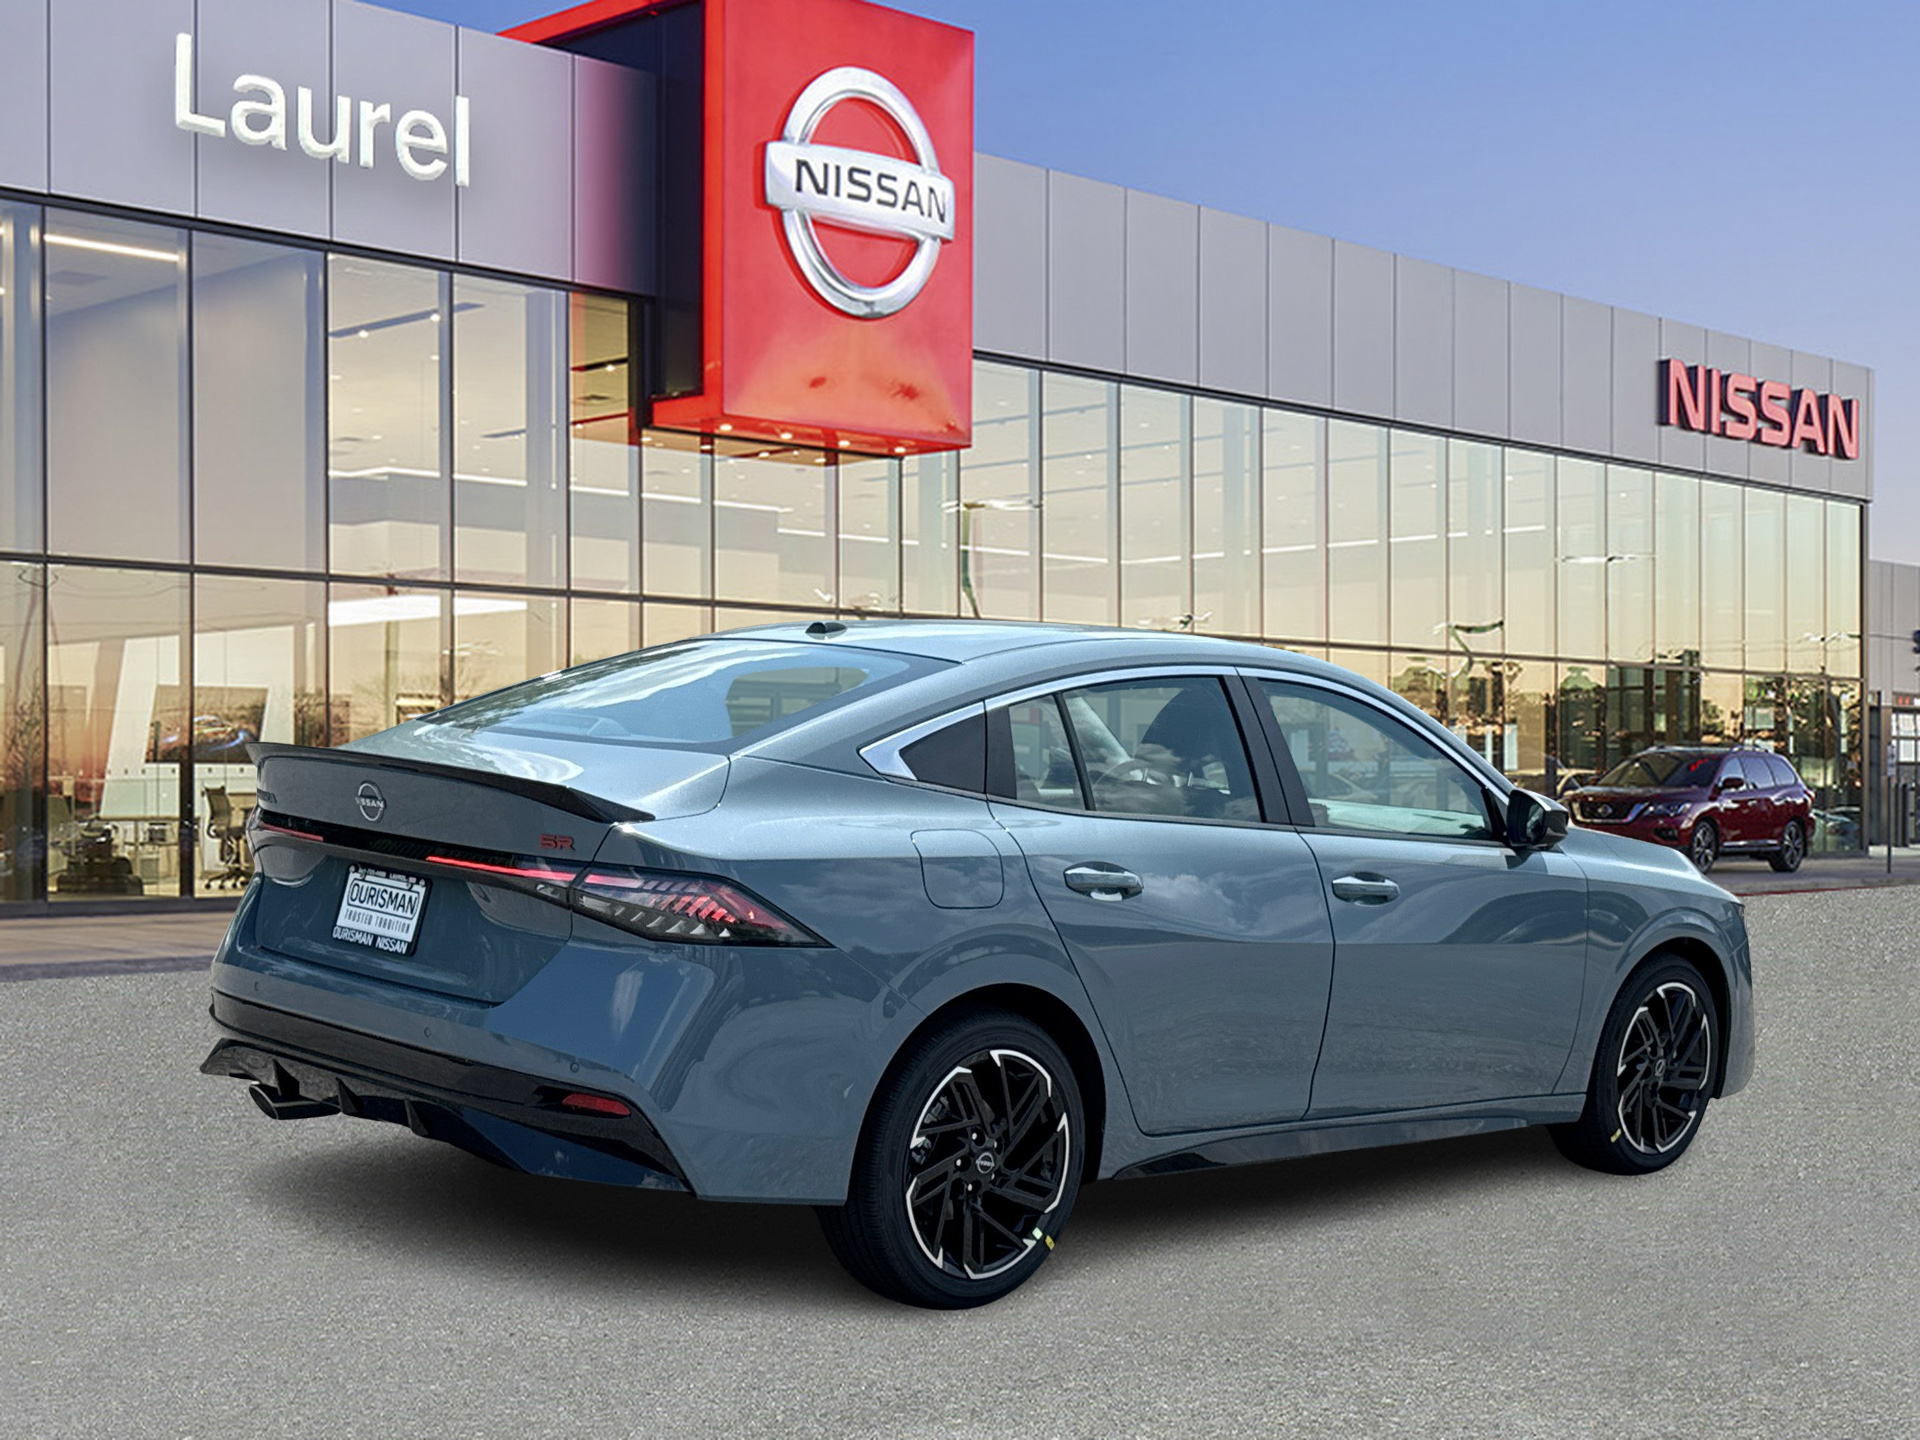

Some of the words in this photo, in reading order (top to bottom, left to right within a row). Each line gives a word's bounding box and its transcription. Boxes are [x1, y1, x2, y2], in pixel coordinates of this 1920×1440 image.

[175, 33, 469, 187] Laurel
[796, 159, 945, 223] NISSAN
[1660, 358, 1859, 459] NISSAN
[539, 834, 575, 850] SR
[350, 883, 417, 915] OURISMAN
[344, 909, 374, 926] TRUSTED
[332, 926, 374, 946] OURISMAN
[375, 936, 408, 954] NISSAN
